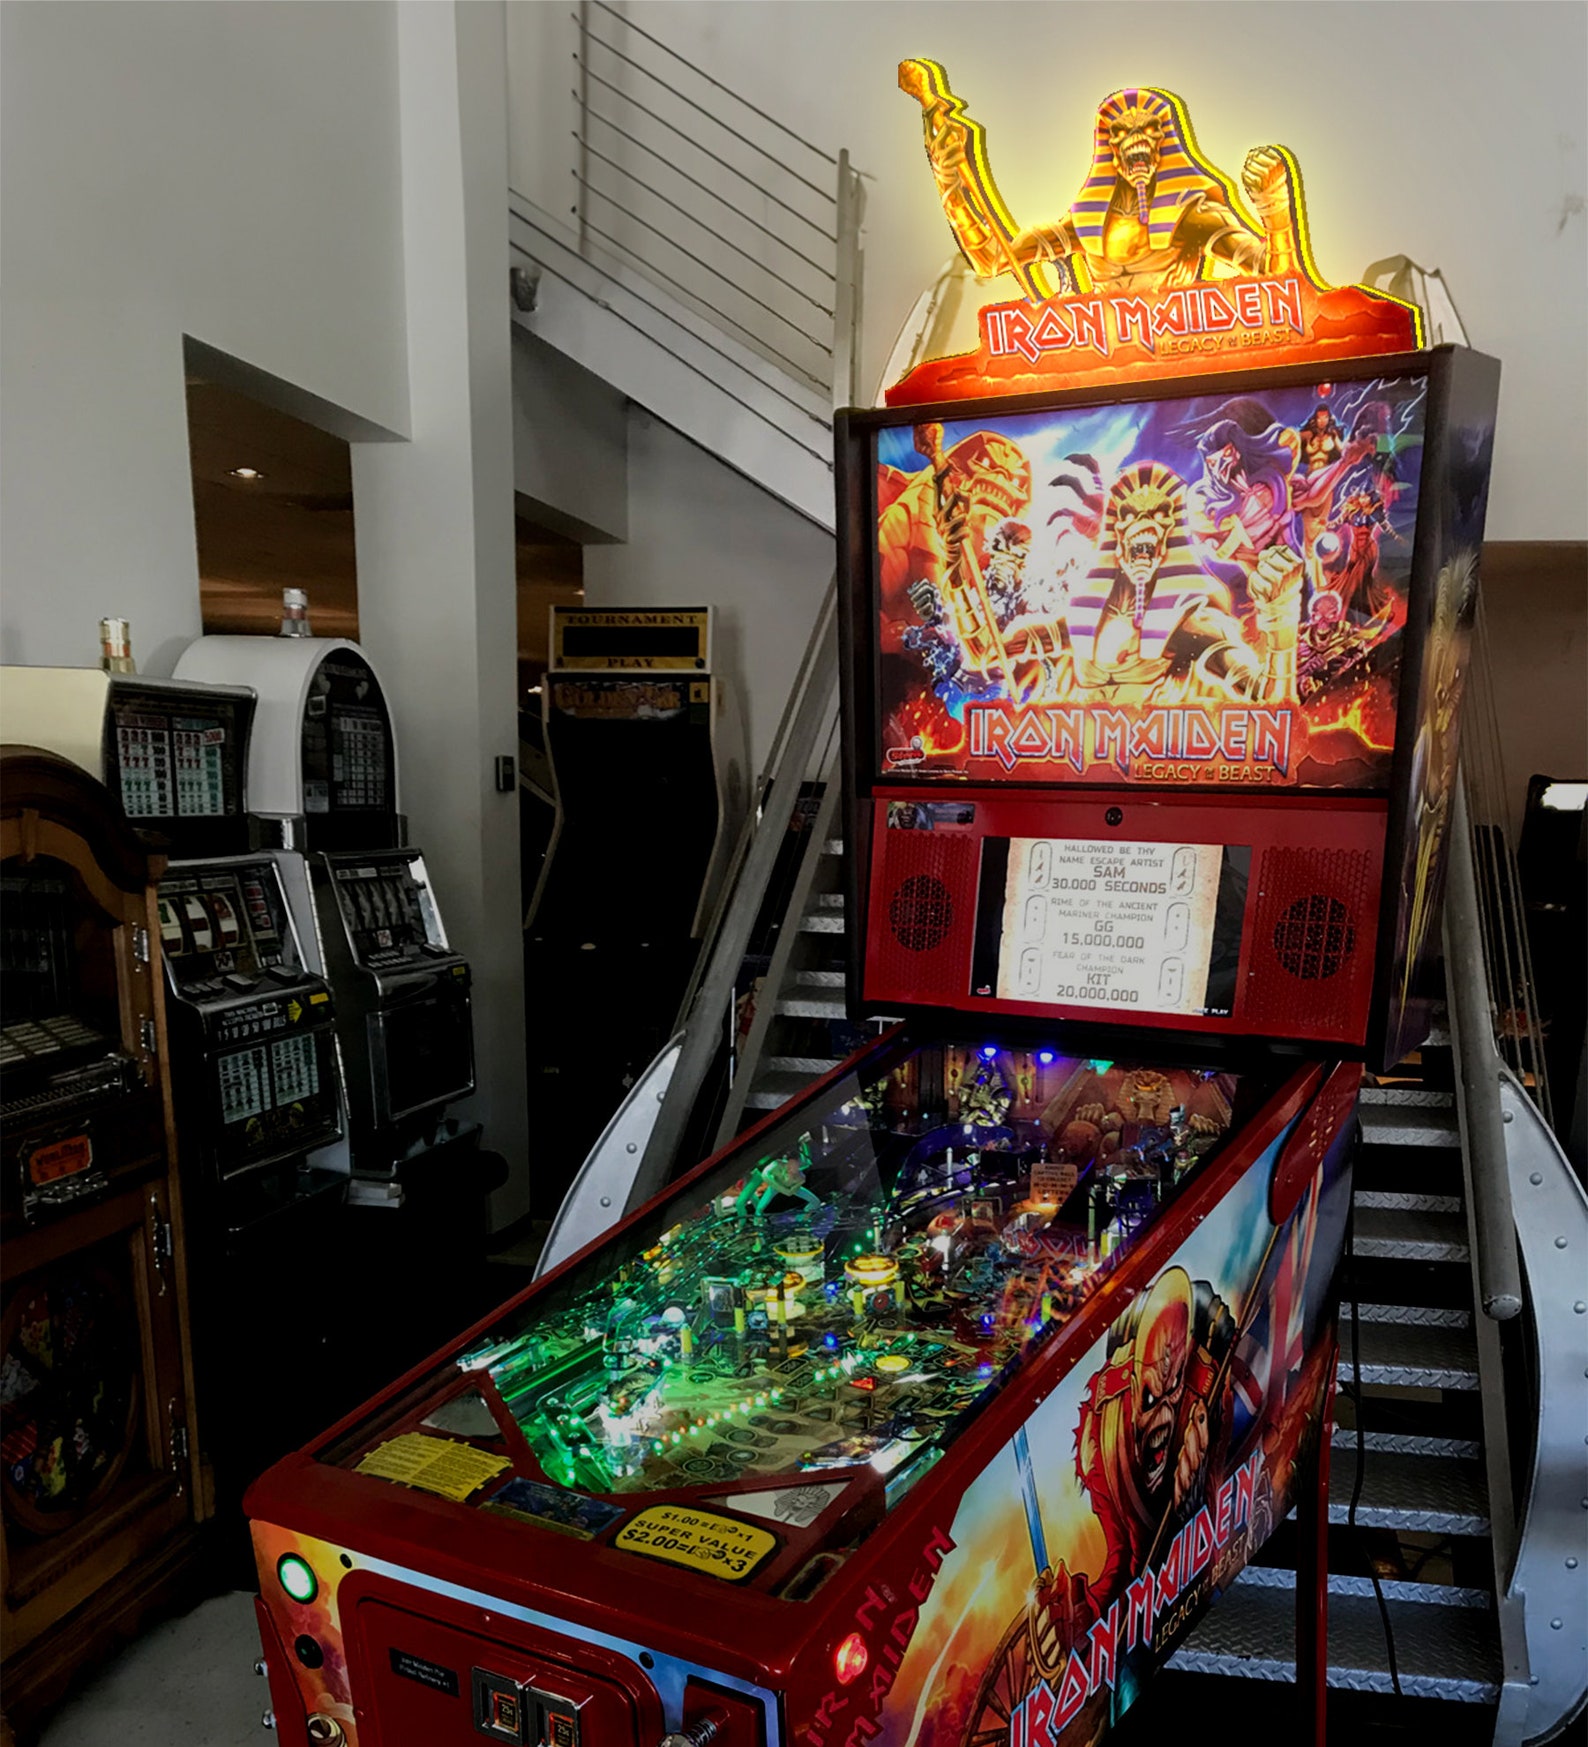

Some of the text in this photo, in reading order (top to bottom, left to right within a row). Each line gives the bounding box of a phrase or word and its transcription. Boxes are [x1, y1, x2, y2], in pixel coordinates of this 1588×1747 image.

[985, 278, 1304, 364] IRON MAIDEN
[1160, 335, 1223, 356] LEGACY
[1240, 327, 1292, 347] BEAST
[566, 614, 698, 625] TOURNAMENT
[607, 658, 655, 668] PLAY
[967, 707, 1292, 778] IRON MAIDEN
[1133, 763, 1202, 781] LEGACY
[1218, 764, 1276, 782] BEAST
[1064, 844, 1156, 856] HALLOWED BE THY
[1059, 856, 1165, 868] NAME ESCAPE ARTIST
[1093, 865, 1126, 878] SAM
[1104, 880, 1167, 894] SECONDS
[1051, 898, 1158, 911] RIME OF THE ANCIENT
[1058, 909, 1154, 922] MARINER CHAMPION
[1094, 920, 1114, 932] GG
[1052, 951, 1145, 964] FEAR OF THE DARK
[1076, 963, 1124, 974] CHAMPION
[1086, 973, 1112, 986] KIT
[661, 1511, 700, 1526] $1.00
[634, 1519, 757, 1559] SUPER VALUE
[1010, 1450, 1259, 1747] IRON MAIDEN
[1154, 1532, 1246, 1654] LEGACY BEAST
[806, 1585, 888, 1747] IRN
